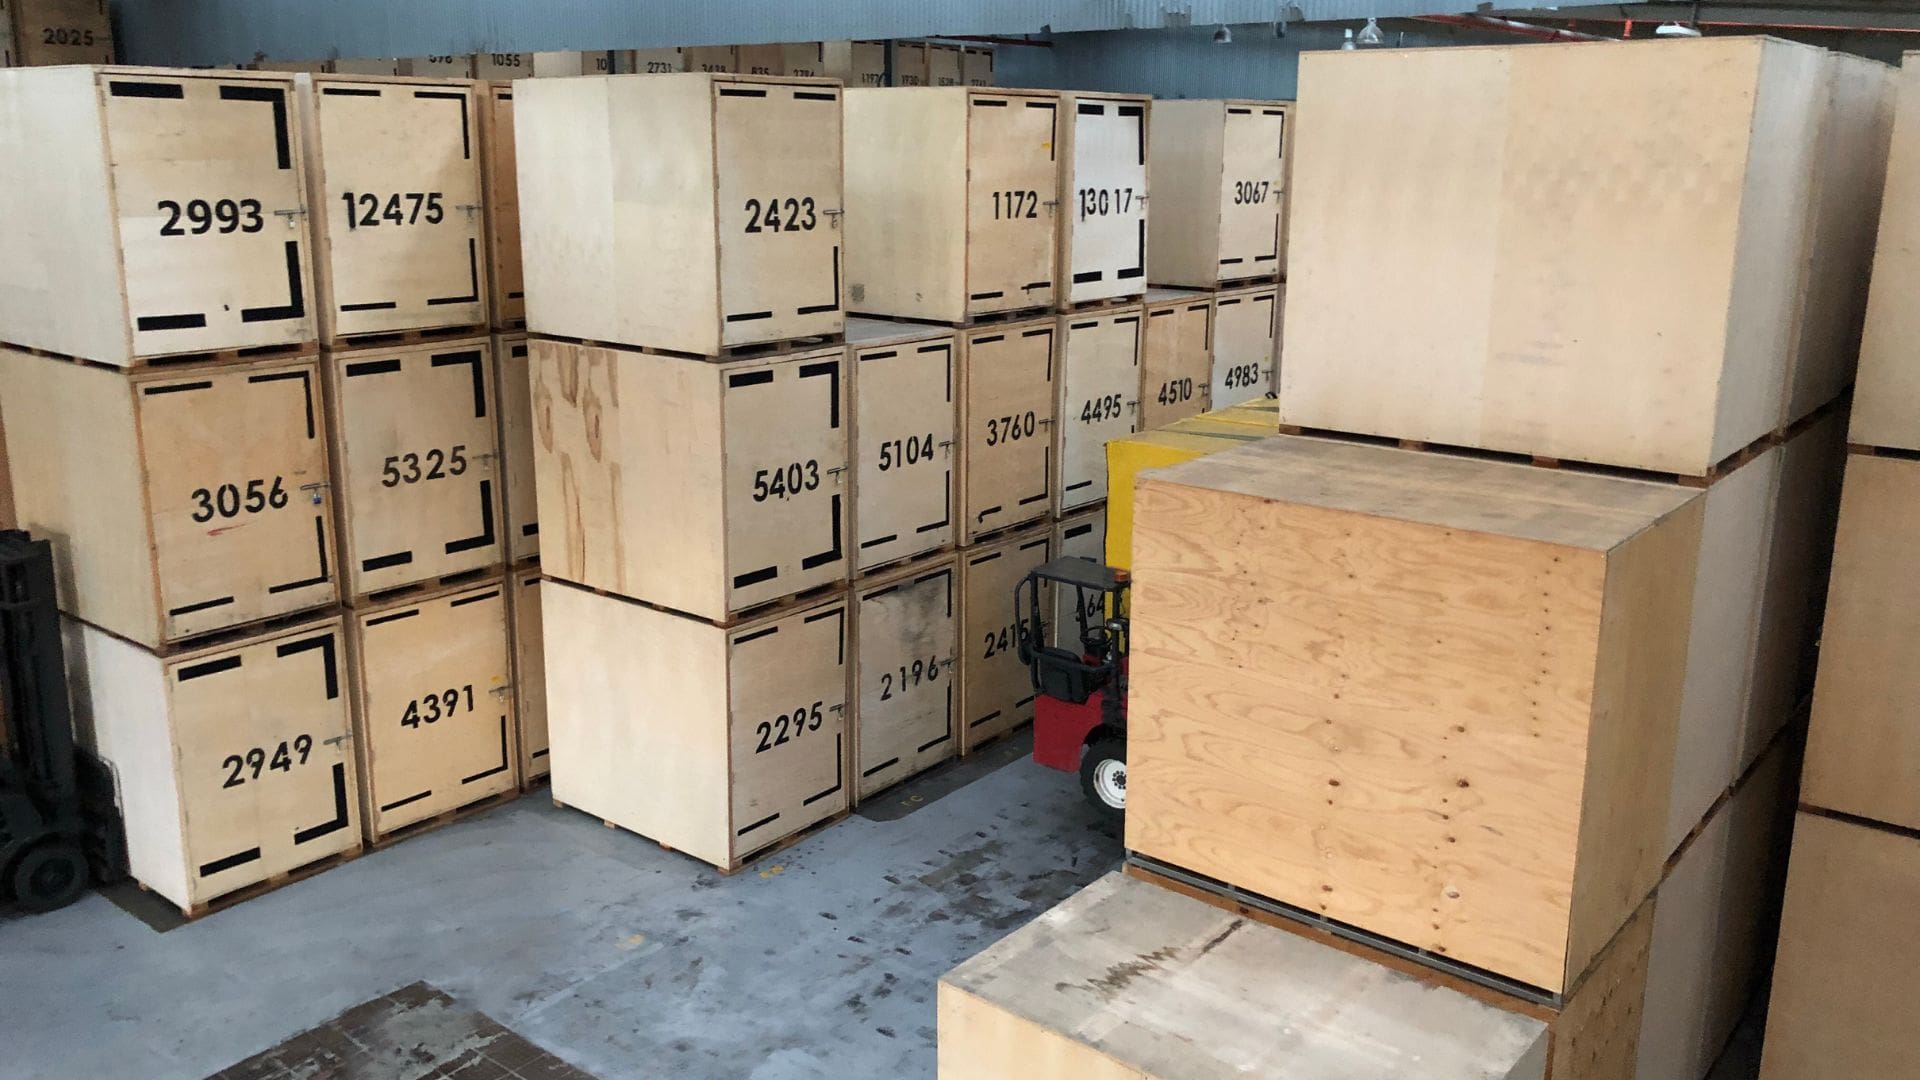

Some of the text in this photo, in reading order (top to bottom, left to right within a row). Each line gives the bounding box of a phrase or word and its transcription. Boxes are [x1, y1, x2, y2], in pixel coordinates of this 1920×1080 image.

[43, 27, 94, 46] 2025
[492, 53, 521, 67] 1055
[647, 61, 672, 74] 2731
[993, 191, 1037, 219] 1172
[1235, 181, 1269, 204] 3067
[158, 199, 263, 236] 2993
[342, 192, 443, 230] 12475
[745, 197, 816, 233] 2423
[1158, 378, 1192, 406] 4510
[1225, 363, 1258, 389] 4983
[1081, 394, 1121, 424] 4495
[987, 411, 1035, 446] 3760
[382, 445, 467, 487] 5325
[879, 434, 933, 471] 5104
[192, 476, 288, 522] 3056
[753, 460, 819, 502] 5403
[881, 657, 939, 701] 2196
[401, 685, 473, 728] 4391
[756, 701, 822, 754] 2295
[223, 734, 312, 789] 2949
